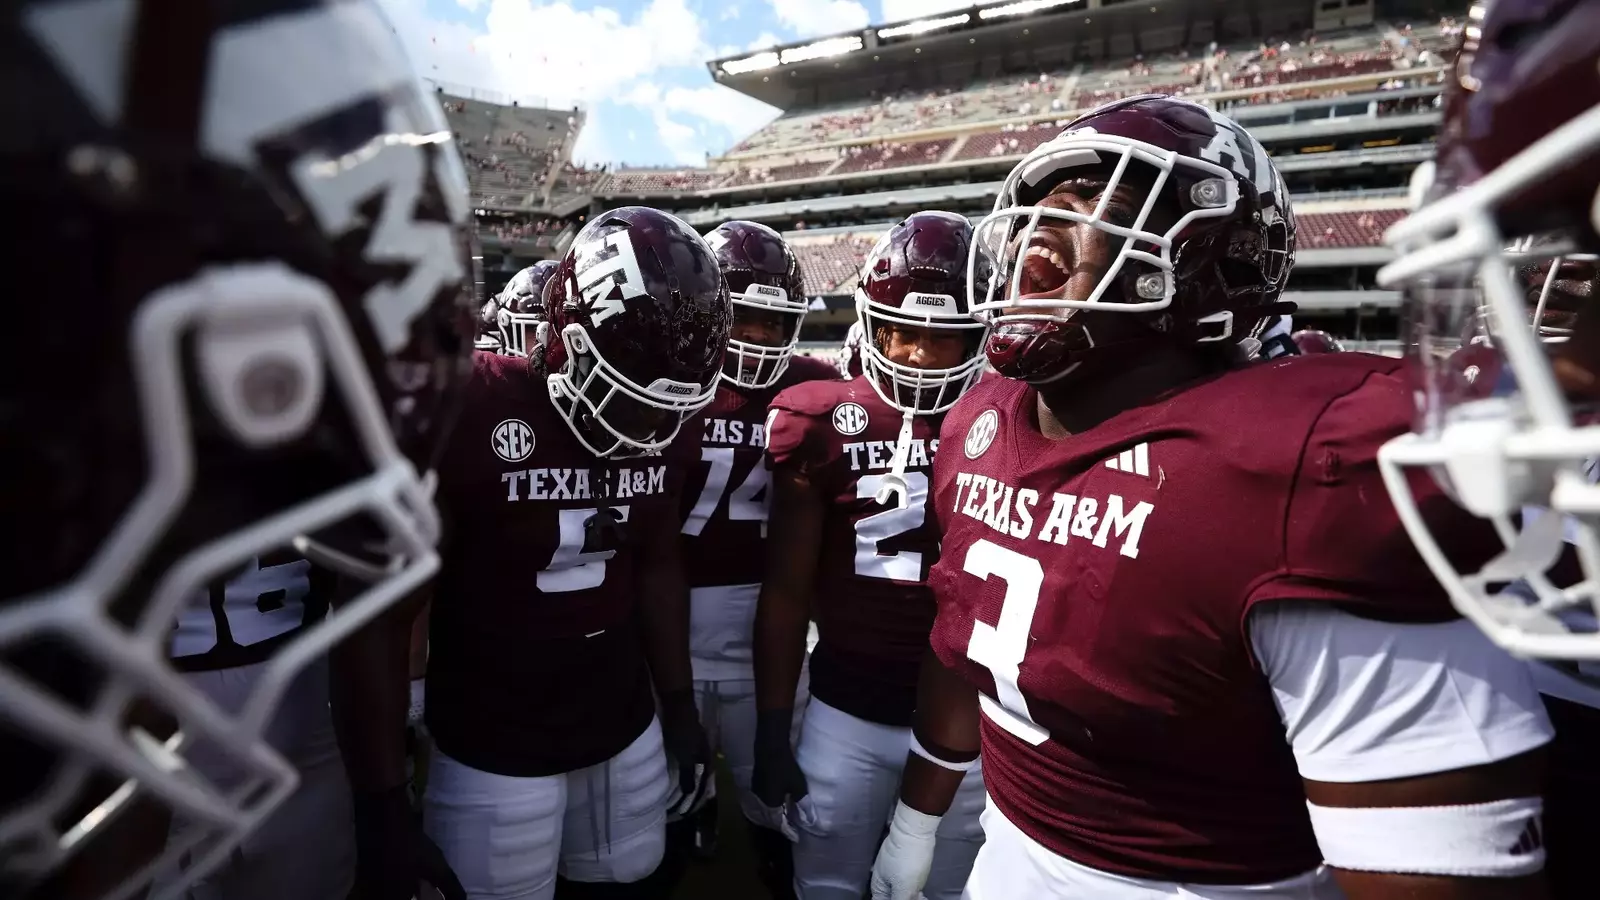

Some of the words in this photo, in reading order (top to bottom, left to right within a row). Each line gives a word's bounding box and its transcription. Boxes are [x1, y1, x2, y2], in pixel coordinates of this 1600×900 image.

[757, 286, 780, 297] AGGIES
[916, 295, 946, 307] AGGIES
[664, 384, 694, 396] AGGIES
[836, 404, 867, 434] SEC
[967, 412, 996, 457] SEC
[494, 421, 533, 460] SEC
[501, 468, 611, 502] TEXA
[616, 465, 667, 499] A&M
[680, 447, 774, 539] 74
[854, 471, 930, 582] 2
[953, 472, 1040, 541] TEXAS
[1037, 491, 1155, 560] A&M
[962, 538, 1051, 746] 3
